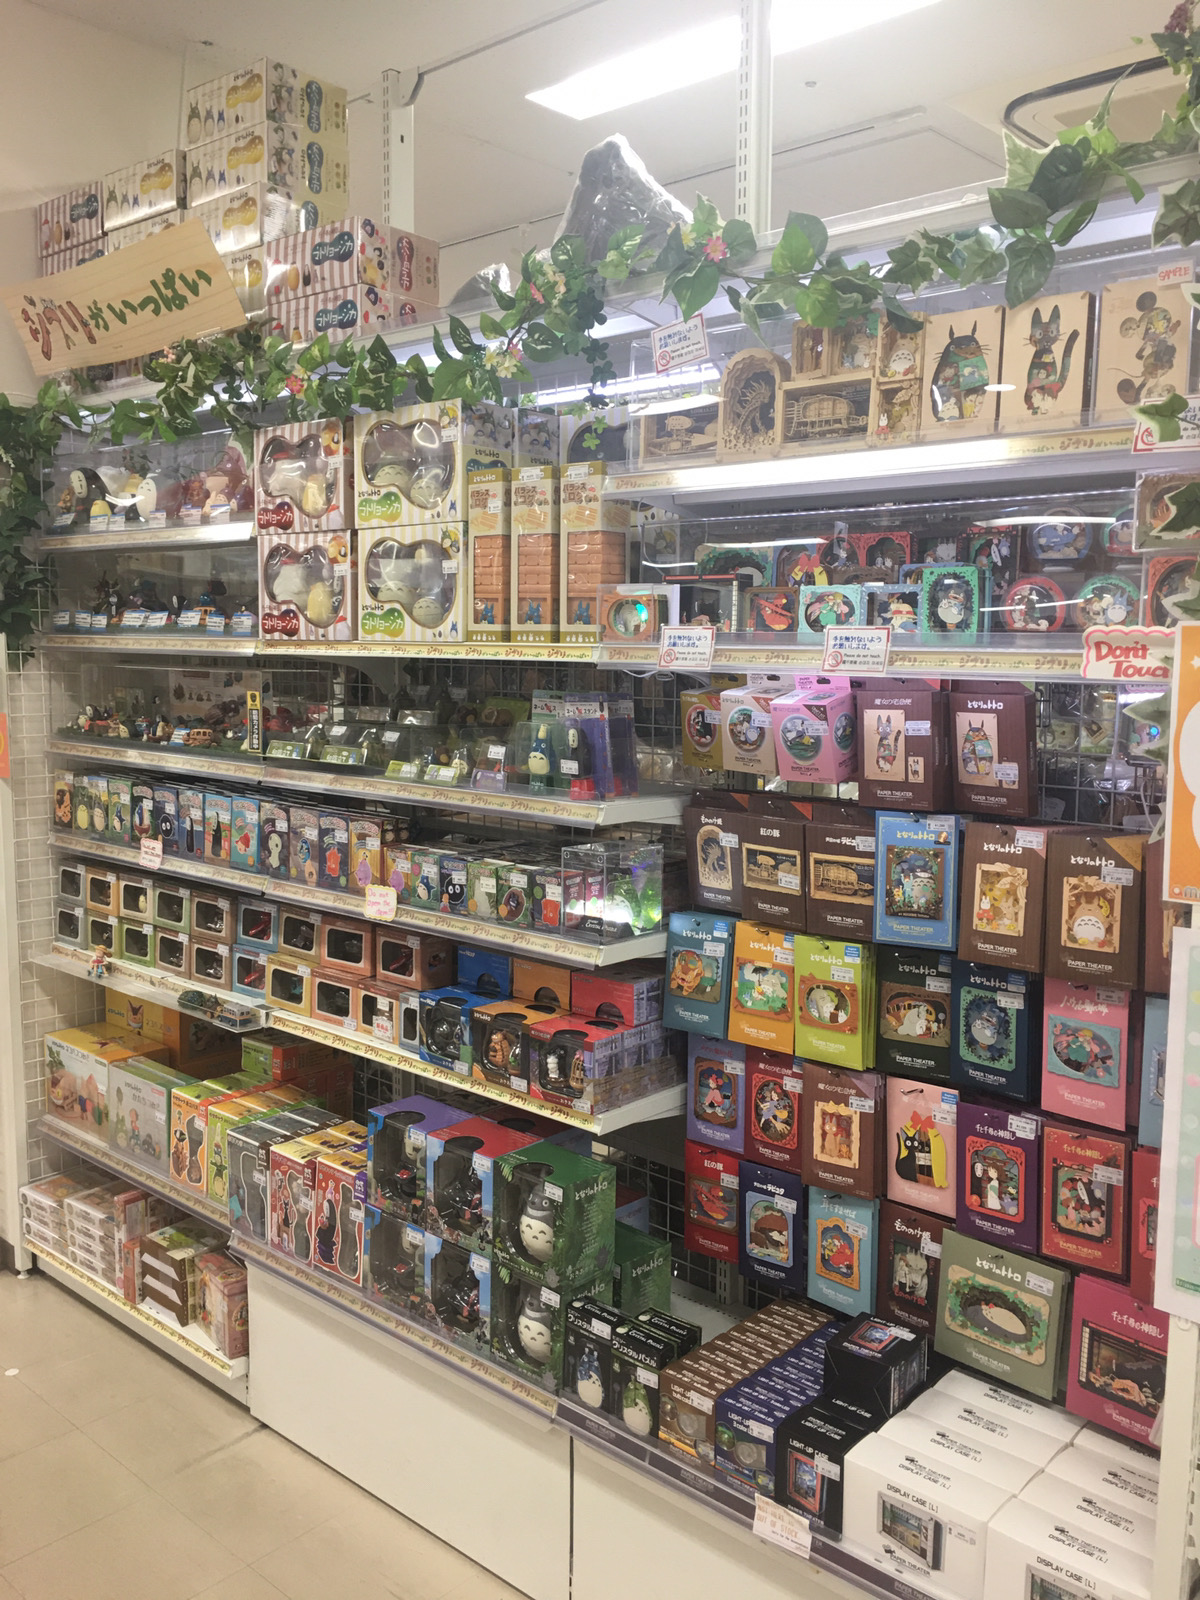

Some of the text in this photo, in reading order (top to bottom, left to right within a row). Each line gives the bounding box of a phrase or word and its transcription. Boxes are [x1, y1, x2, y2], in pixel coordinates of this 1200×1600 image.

[1158, 266, 1191, 281] SAMPLE
[1094, 641, 1149, 662] Don't
[967, 700, 1004, 709] となりのトトロ
[760, 827, 780, 838] 紅の豚
[896, 831, 935, 841] となりのトトロ
[983, 843, 1022, 854] となりのトトロ
[1070, 855, 1115, 867] となりのトトロ
[683, 930, 712, 940] となりのトトロ
[994, 945, 1017, 953] THEATER
[810, 954, 843, 965] となりのトトロ
[1067, 959, 1113, 971] PAPER THEATER
[898, 964, 937, 976] となりのトトロ
[970, 975, 1006, 989] となりのトトロ
[896, 1055, 935, 1066] PAPER THEATER
[969, 1069, 1006, 1082] PAPER THEATER
[704, 1160, 724, 1170] 紅の豚
[975, 1219, 1015, 1234] PAPER THEATER
[975, 1257, 1022, 1281] となりのトトロ
[1112, 1311, 1164, 1339] 千と千尋の神隠し
[831, 1398, 873, 1419] LIGHT-UP CASE
[957, 1414, 981, 1427] DISPLAY
[982, 1423, 998, 1433] CASE
[789, 1438, 814, 1455] LIGHT-UP
[930, 1438, 954, 1452] DISPLAY
[954, 1447, 971, 1459] CASE
[898, 1463, 923, 1478] DISPLAY
[923, 1474, 940, 1485] CASE
[887, 1483, 911, 1500] DISPLAY
[911, 1495, 928, 1508] CASE
[1102, 1477, 1128, 1492] DISPLAY
[1129, 1489, 1147, 1500] CASE
[1076, 1505, 1103, 1520] DISPLAY
[1103, 1517, 1121, 1529] CASE
[780, 1523, 799, 1538] STOCK
[1048, 1533, 1075, 1550] DISPLAY
[1076, 1547, 1095, 1559] CASE
[890, 1554, 931, 1576] PAPER THEATER
[1036, 1556, 1064, 1574] DISPLAY
[1065, 1570, 1083, 1583] CASE
